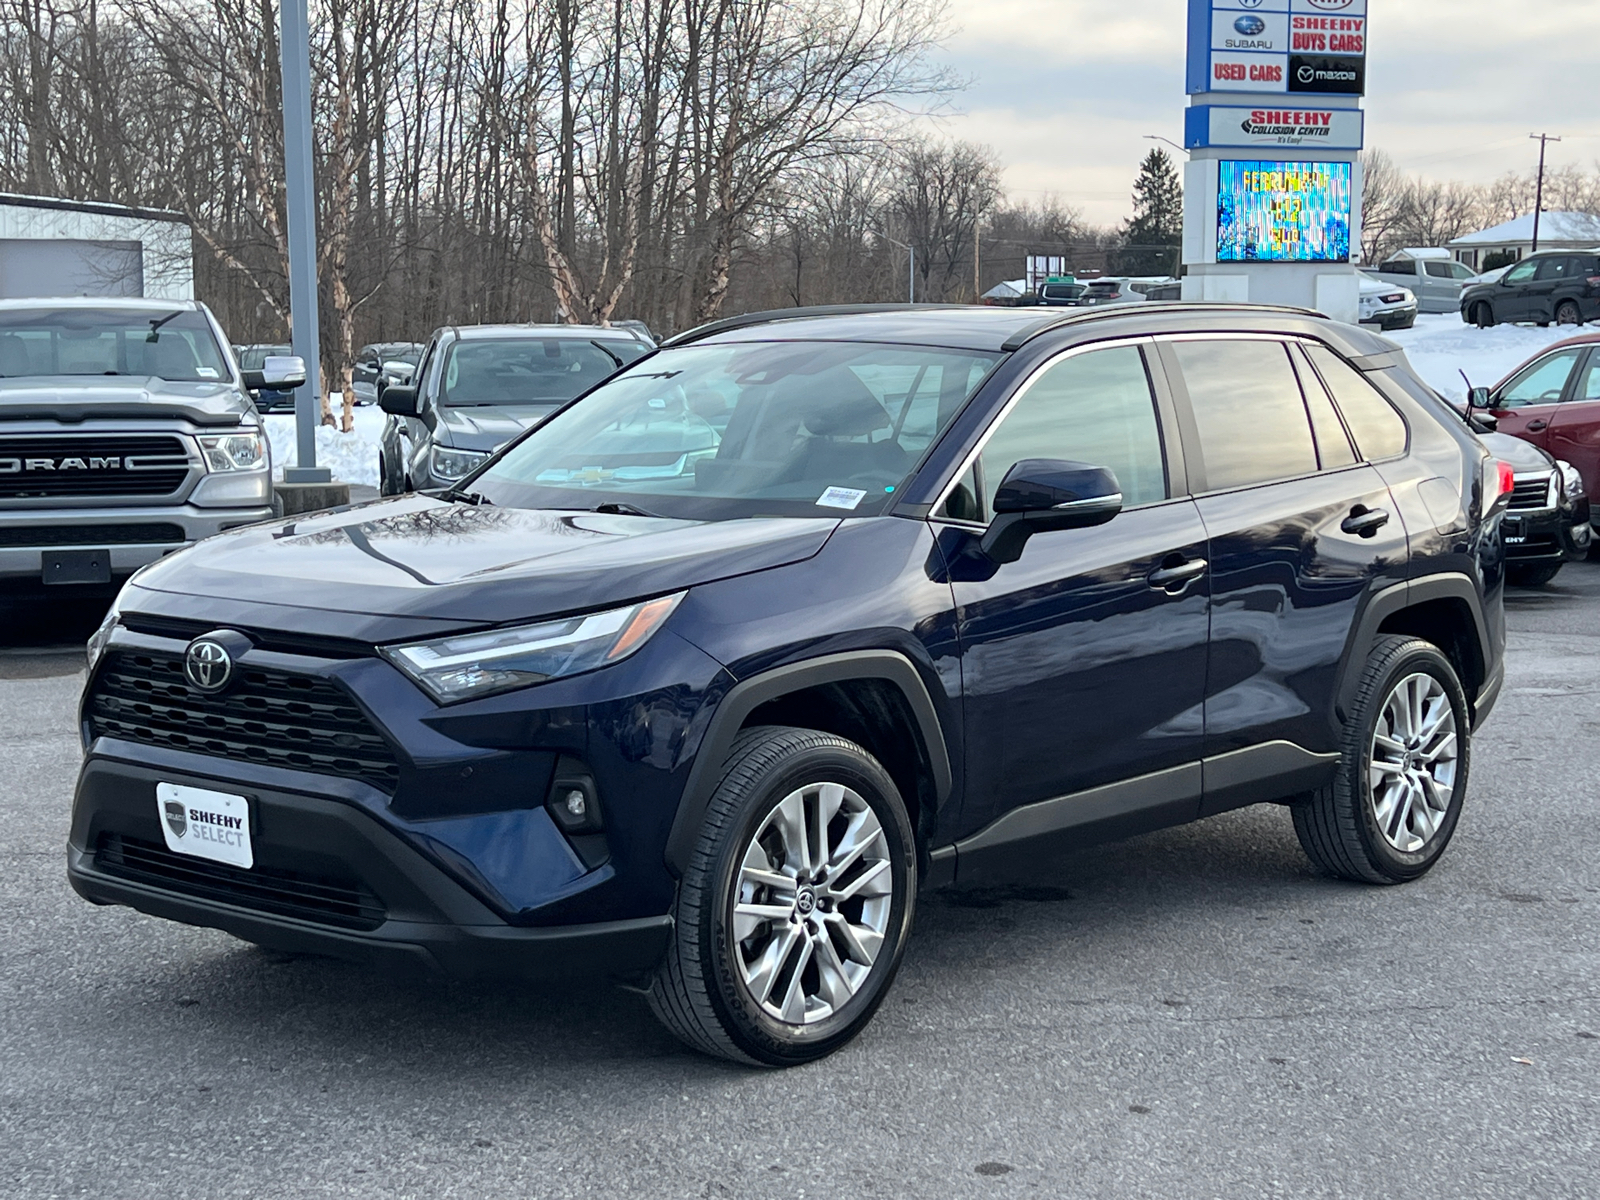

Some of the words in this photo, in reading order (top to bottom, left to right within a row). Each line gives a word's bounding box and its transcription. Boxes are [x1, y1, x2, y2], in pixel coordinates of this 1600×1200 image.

[1292, 17, 1363, 31] SHEEHY
[1225, 39, 1273, 50] SUBARU
[1293, 32, 1326, 51] BUYS
[1329, 33, 1363, 53] CARS
[1214, 63, 1246, 80] USED
[1249, 65, 1282, 82] CARS
[1315, 70, 1356, 81] mazda
[1251, 110, 1332, 125] SHEEHY
[1251, 125, 1296, 135] COLLISION
[1298, 126, 1330, 136] CENTER
[25, 457, 120, 471] RAM
[189, 808, 242, 830] SHEEHY
[192, 823, 243, 848] SELECT
